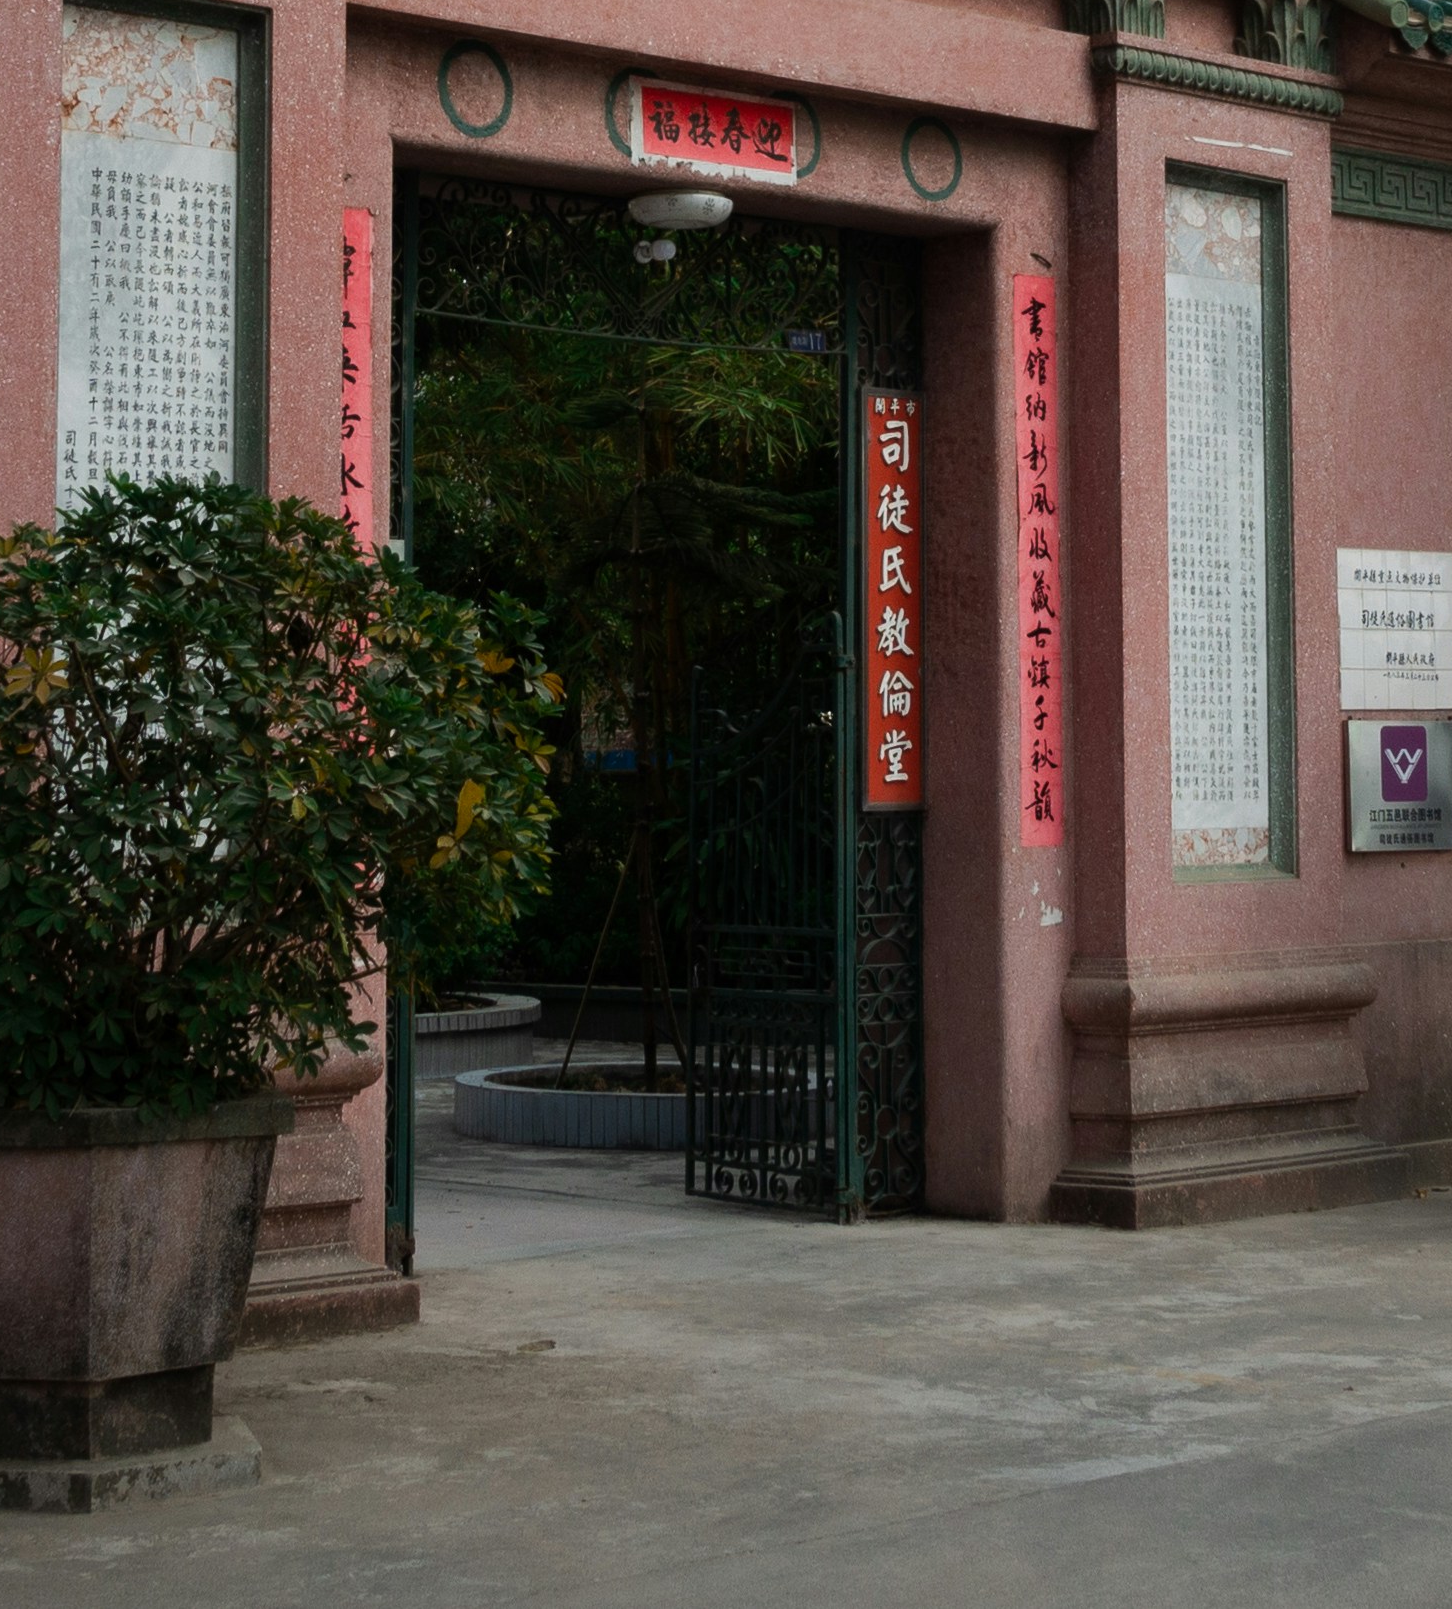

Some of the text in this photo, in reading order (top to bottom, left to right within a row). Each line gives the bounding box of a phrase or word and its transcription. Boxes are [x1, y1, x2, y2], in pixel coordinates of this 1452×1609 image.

[876, 421, 914, 782] 司徒氏教倫堂
